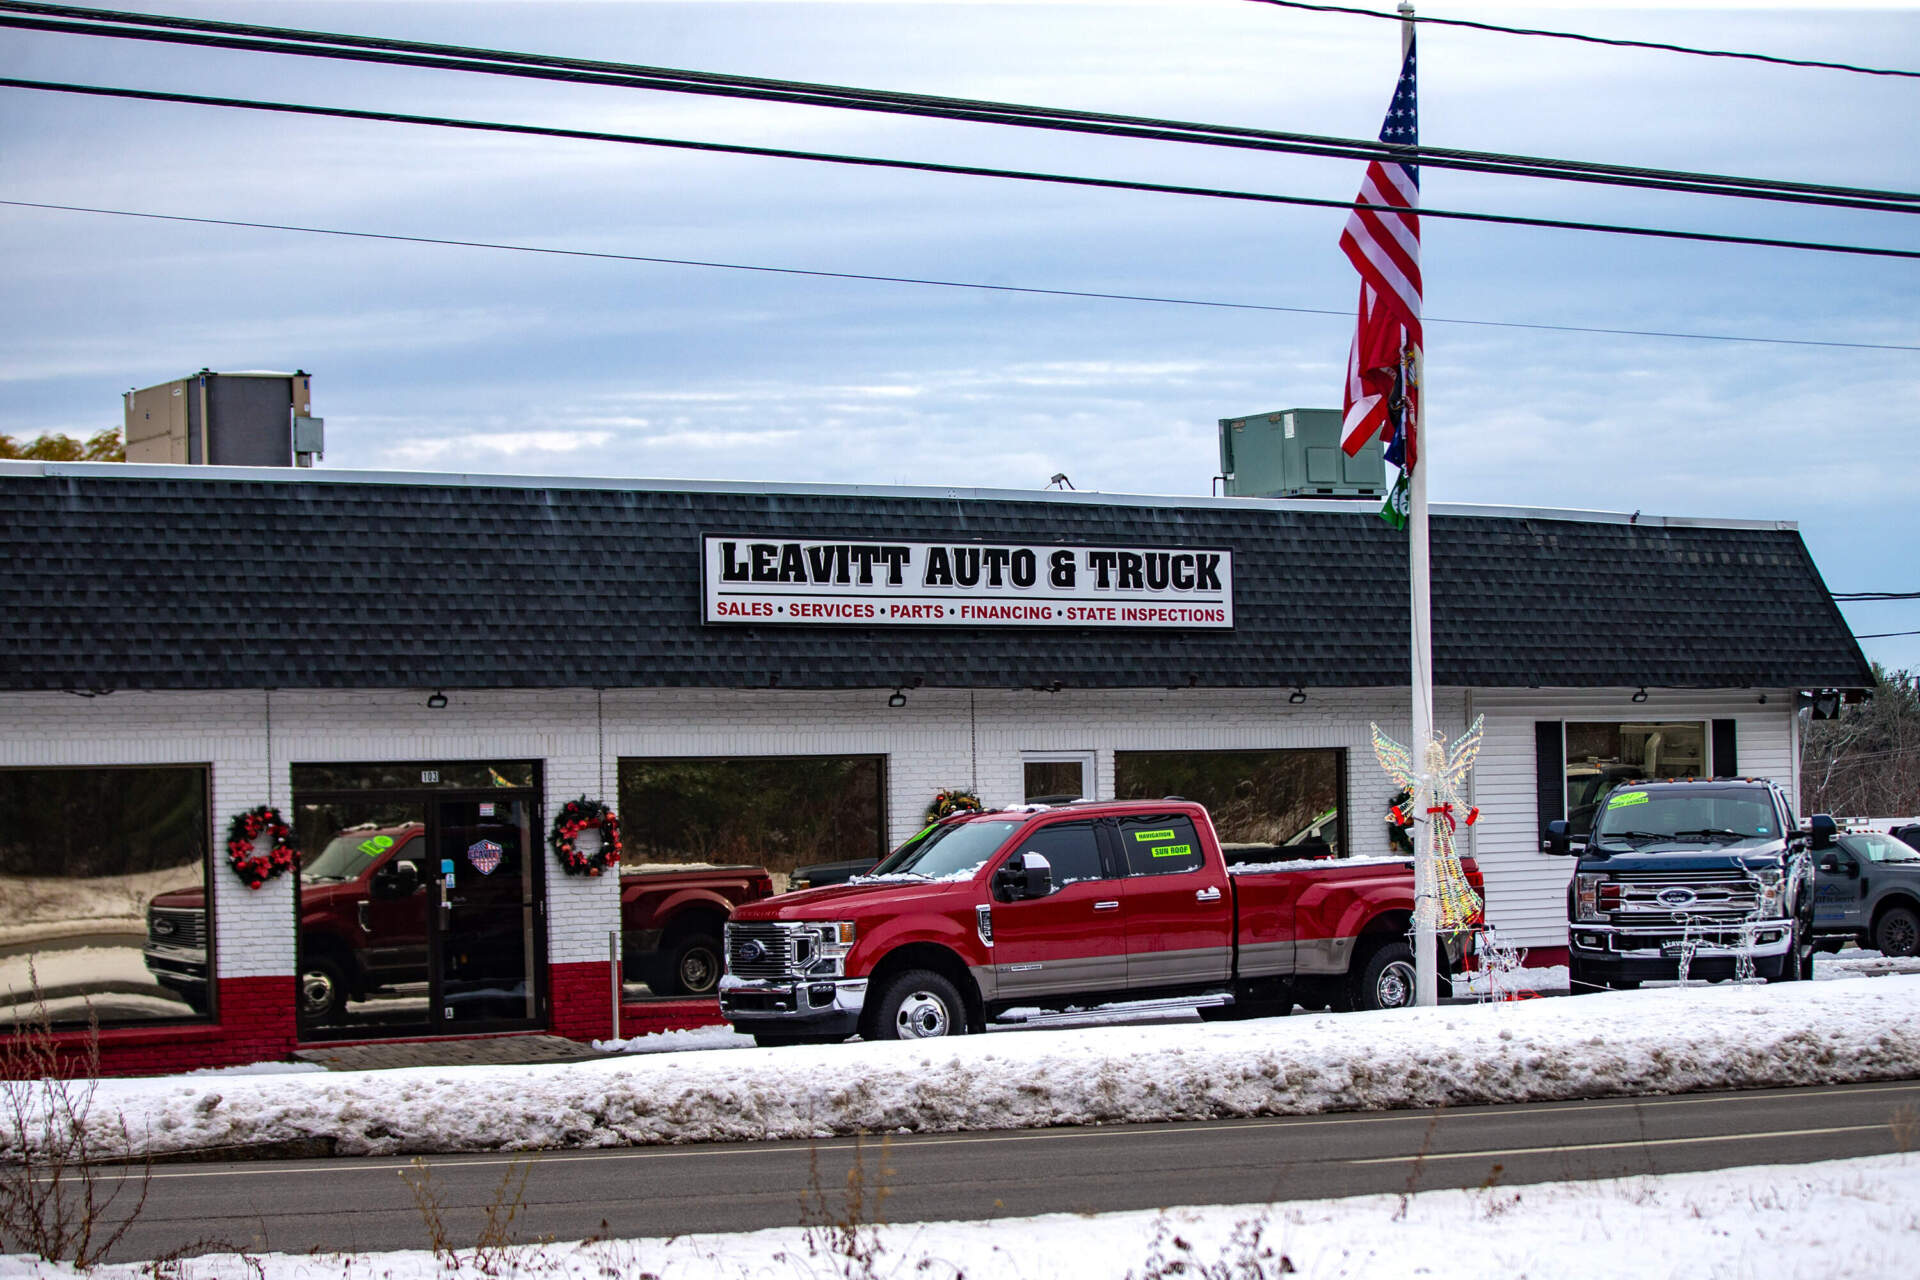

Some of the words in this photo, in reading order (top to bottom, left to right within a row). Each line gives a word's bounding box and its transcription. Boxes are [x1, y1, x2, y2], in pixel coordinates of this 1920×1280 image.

[719, 542, 911, 587] LEAVITT
[922, 546, 1037, 589] AUTO
[1049, 549, 1077, 590] &
[1087, 551, 1223, 593] TRUCK
[716, 601, 774, 617] SALES
[788, 602, 875, 618] SERVICES
[889, 604, 945, 619] PARTS
[960, 605, 1052, 620] FINANCING
[1066, 607, 1117, 621] STATE
[1120, 608, 1225, 622] INSPECTIONS
[423, 770, 439, 783] 103
[1138, 831, 1171, 839] NAVIGATION
[1154, 847, 1169, 856] SUN
[1170, 845, 1188, 854] ROOF
